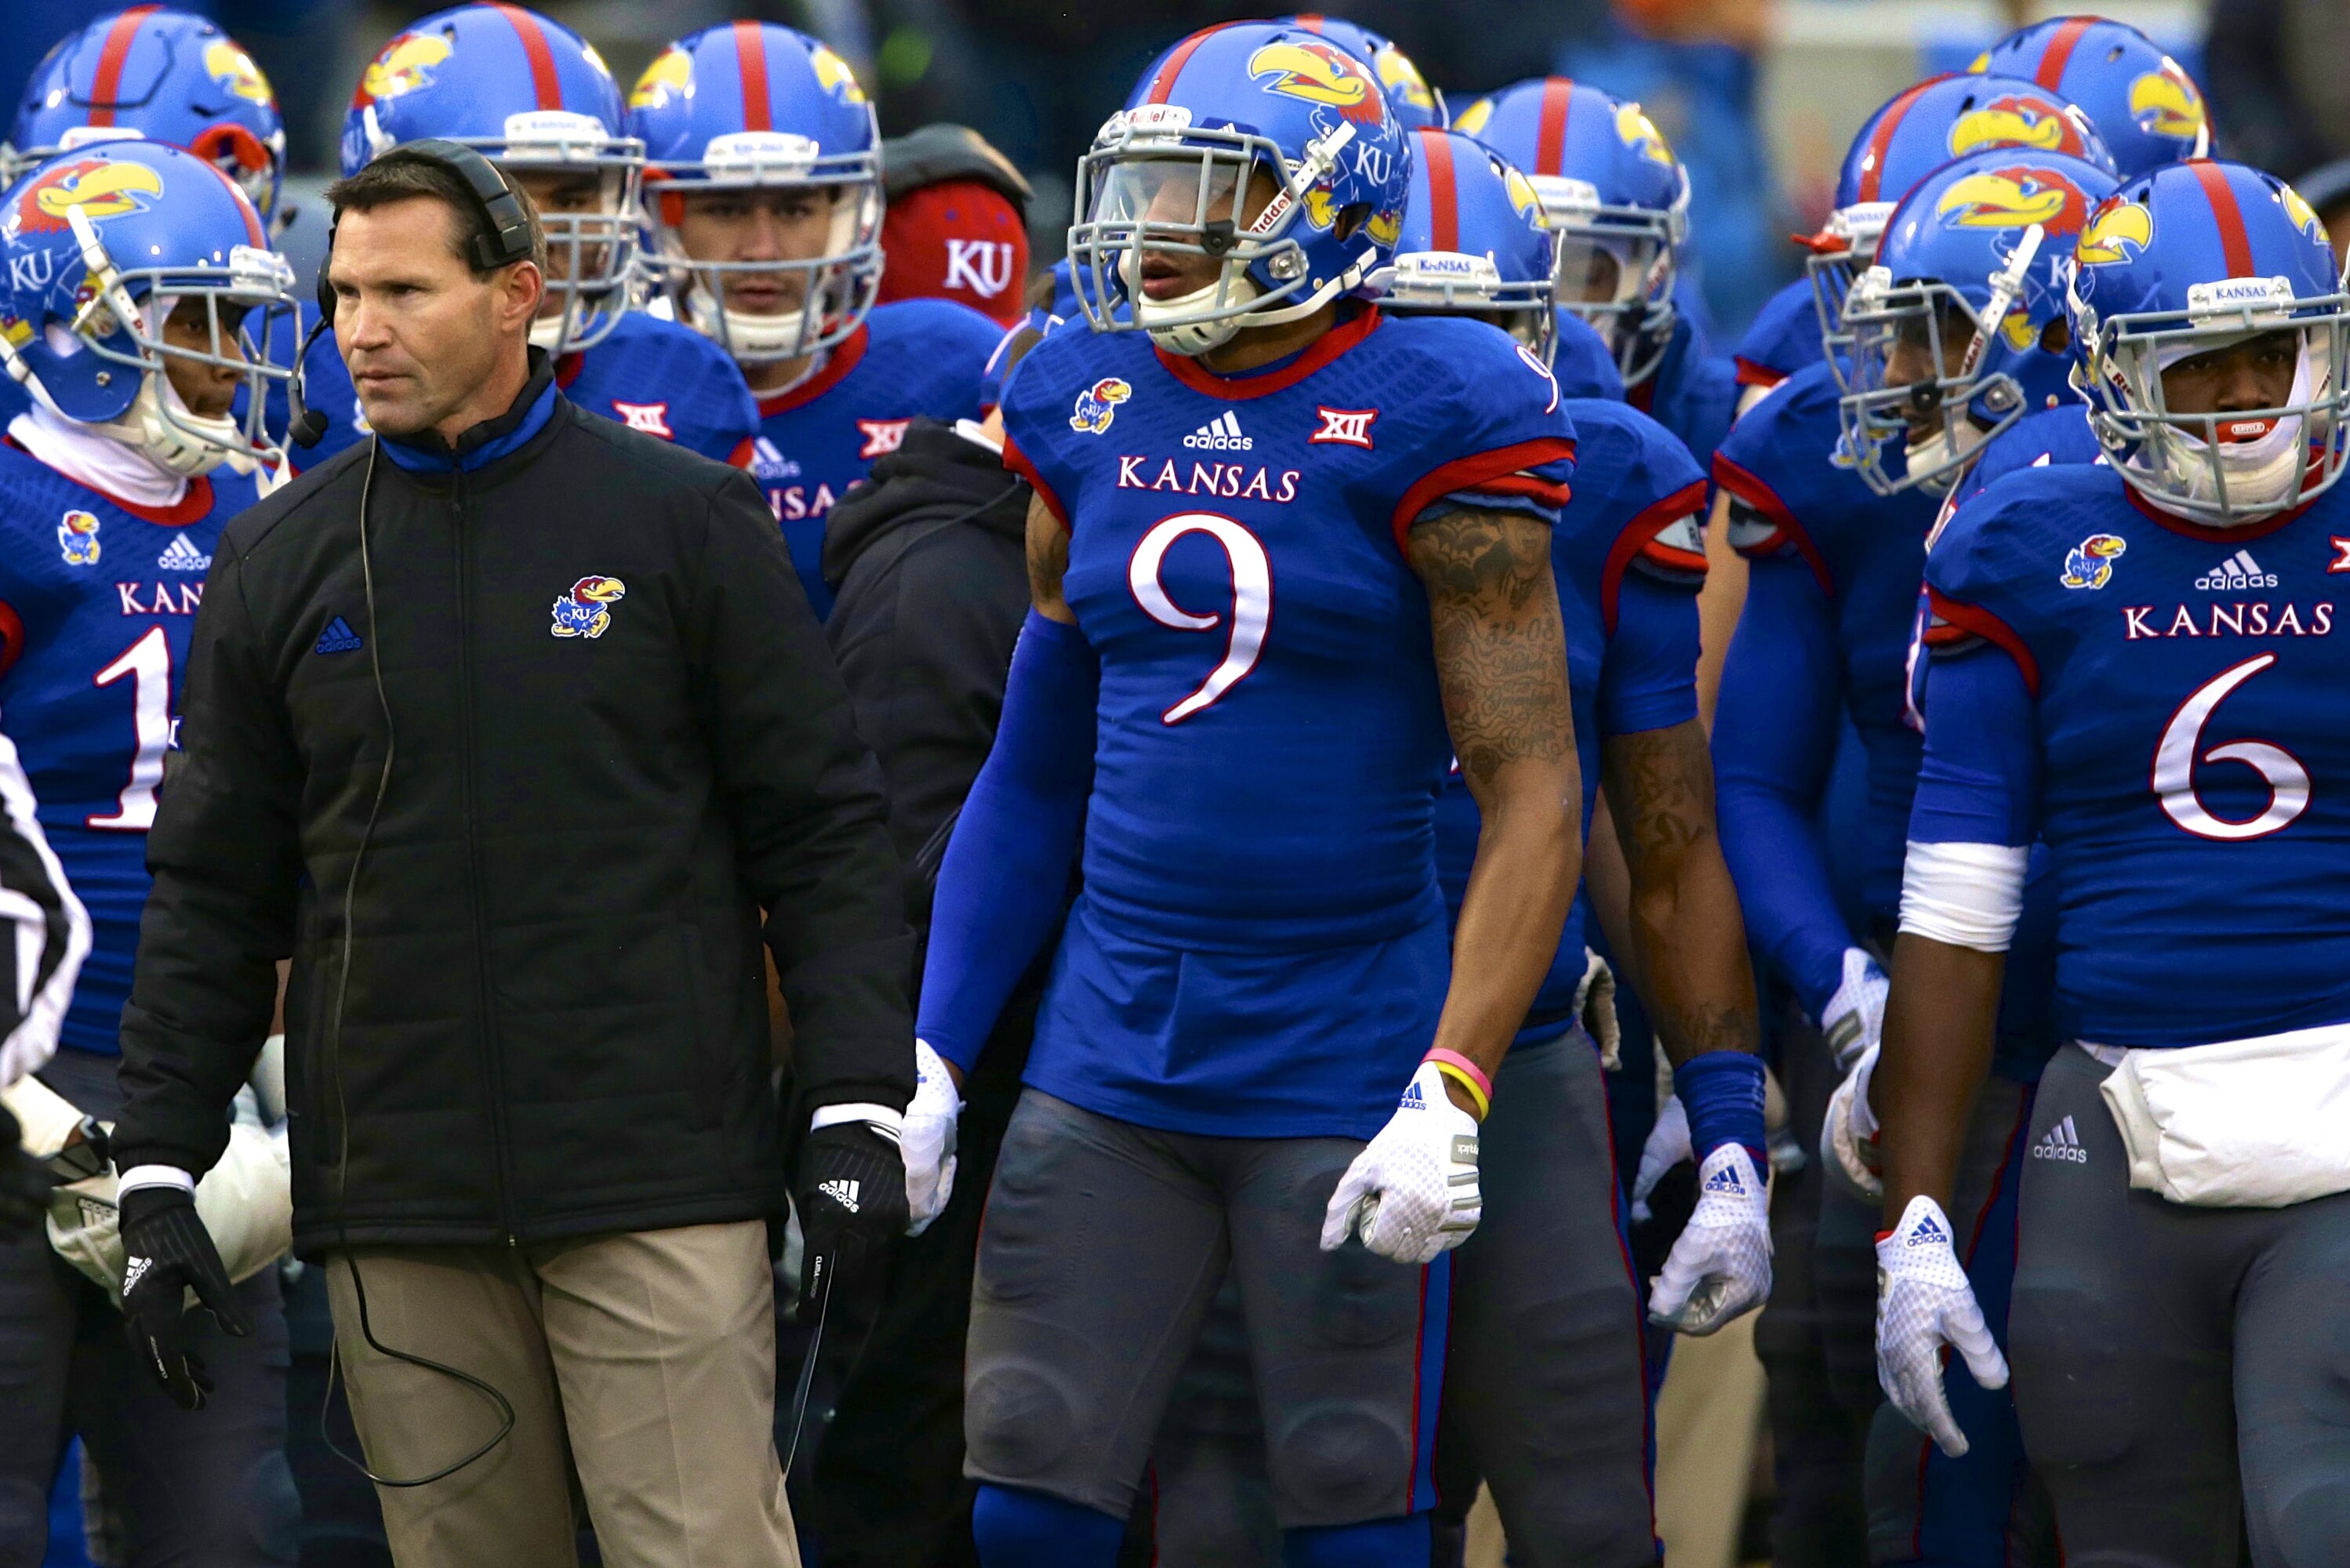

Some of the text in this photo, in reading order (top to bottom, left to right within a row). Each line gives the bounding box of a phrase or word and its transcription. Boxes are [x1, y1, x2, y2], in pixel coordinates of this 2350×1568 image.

[1353, 140, 1393, 187] KU
[9, 248, 53, 291] KU
[943, 238, 1014, 299] KU
[2216, 285, 2268, 299] KANSAS
[1515, 344, 1560, 415] 9
[1182, 433, 1253, 450] adidas
[1313, 409, 1374, 445] XII
[1117, 456, 1301, 503] KANSAS
[117, 581, 207, 615] KAN
[2196, 573, 2279, 590] adidas
[572, 608, 590, 621] KU
[1128, 510, 1274, 726] 9
[2123, 601, 2334, 640] KANSAS
[316, 637, 361, 654] adidas
[86, 624, 173, 833] 1
[2152, 652, 2314, 840] 6
[2033, 1144, 2087, 1163] adidas
[819, 1182, 860, 1213] adidas
[122, 1257, 153, 1297] adidas
